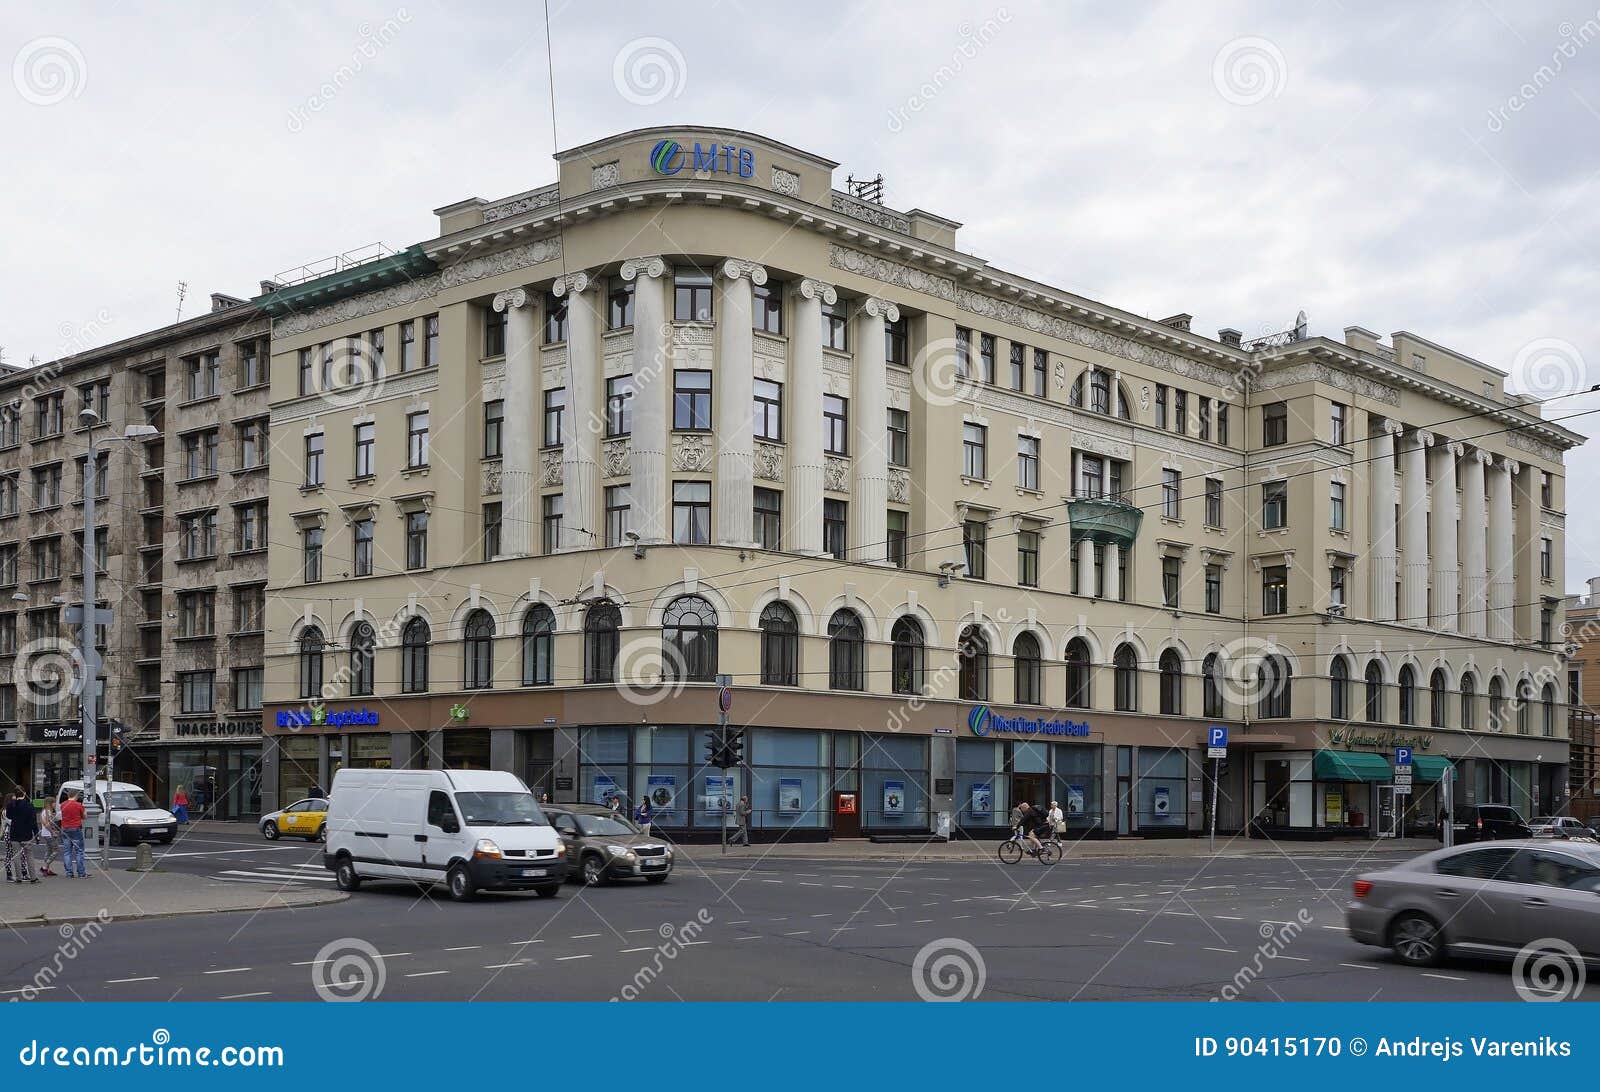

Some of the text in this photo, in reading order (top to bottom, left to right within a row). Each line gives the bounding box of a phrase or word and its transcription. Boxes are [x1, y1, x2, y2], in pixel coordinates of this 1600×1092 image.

[693, 142, 755, 178] MTB
[44, 727, 78, 739] Sony Center
[992, 714, 1090, 737] Meridian Trade Bank
[1213, 729, 1224, 745] P
[1399, 749, 1408, 763] P
